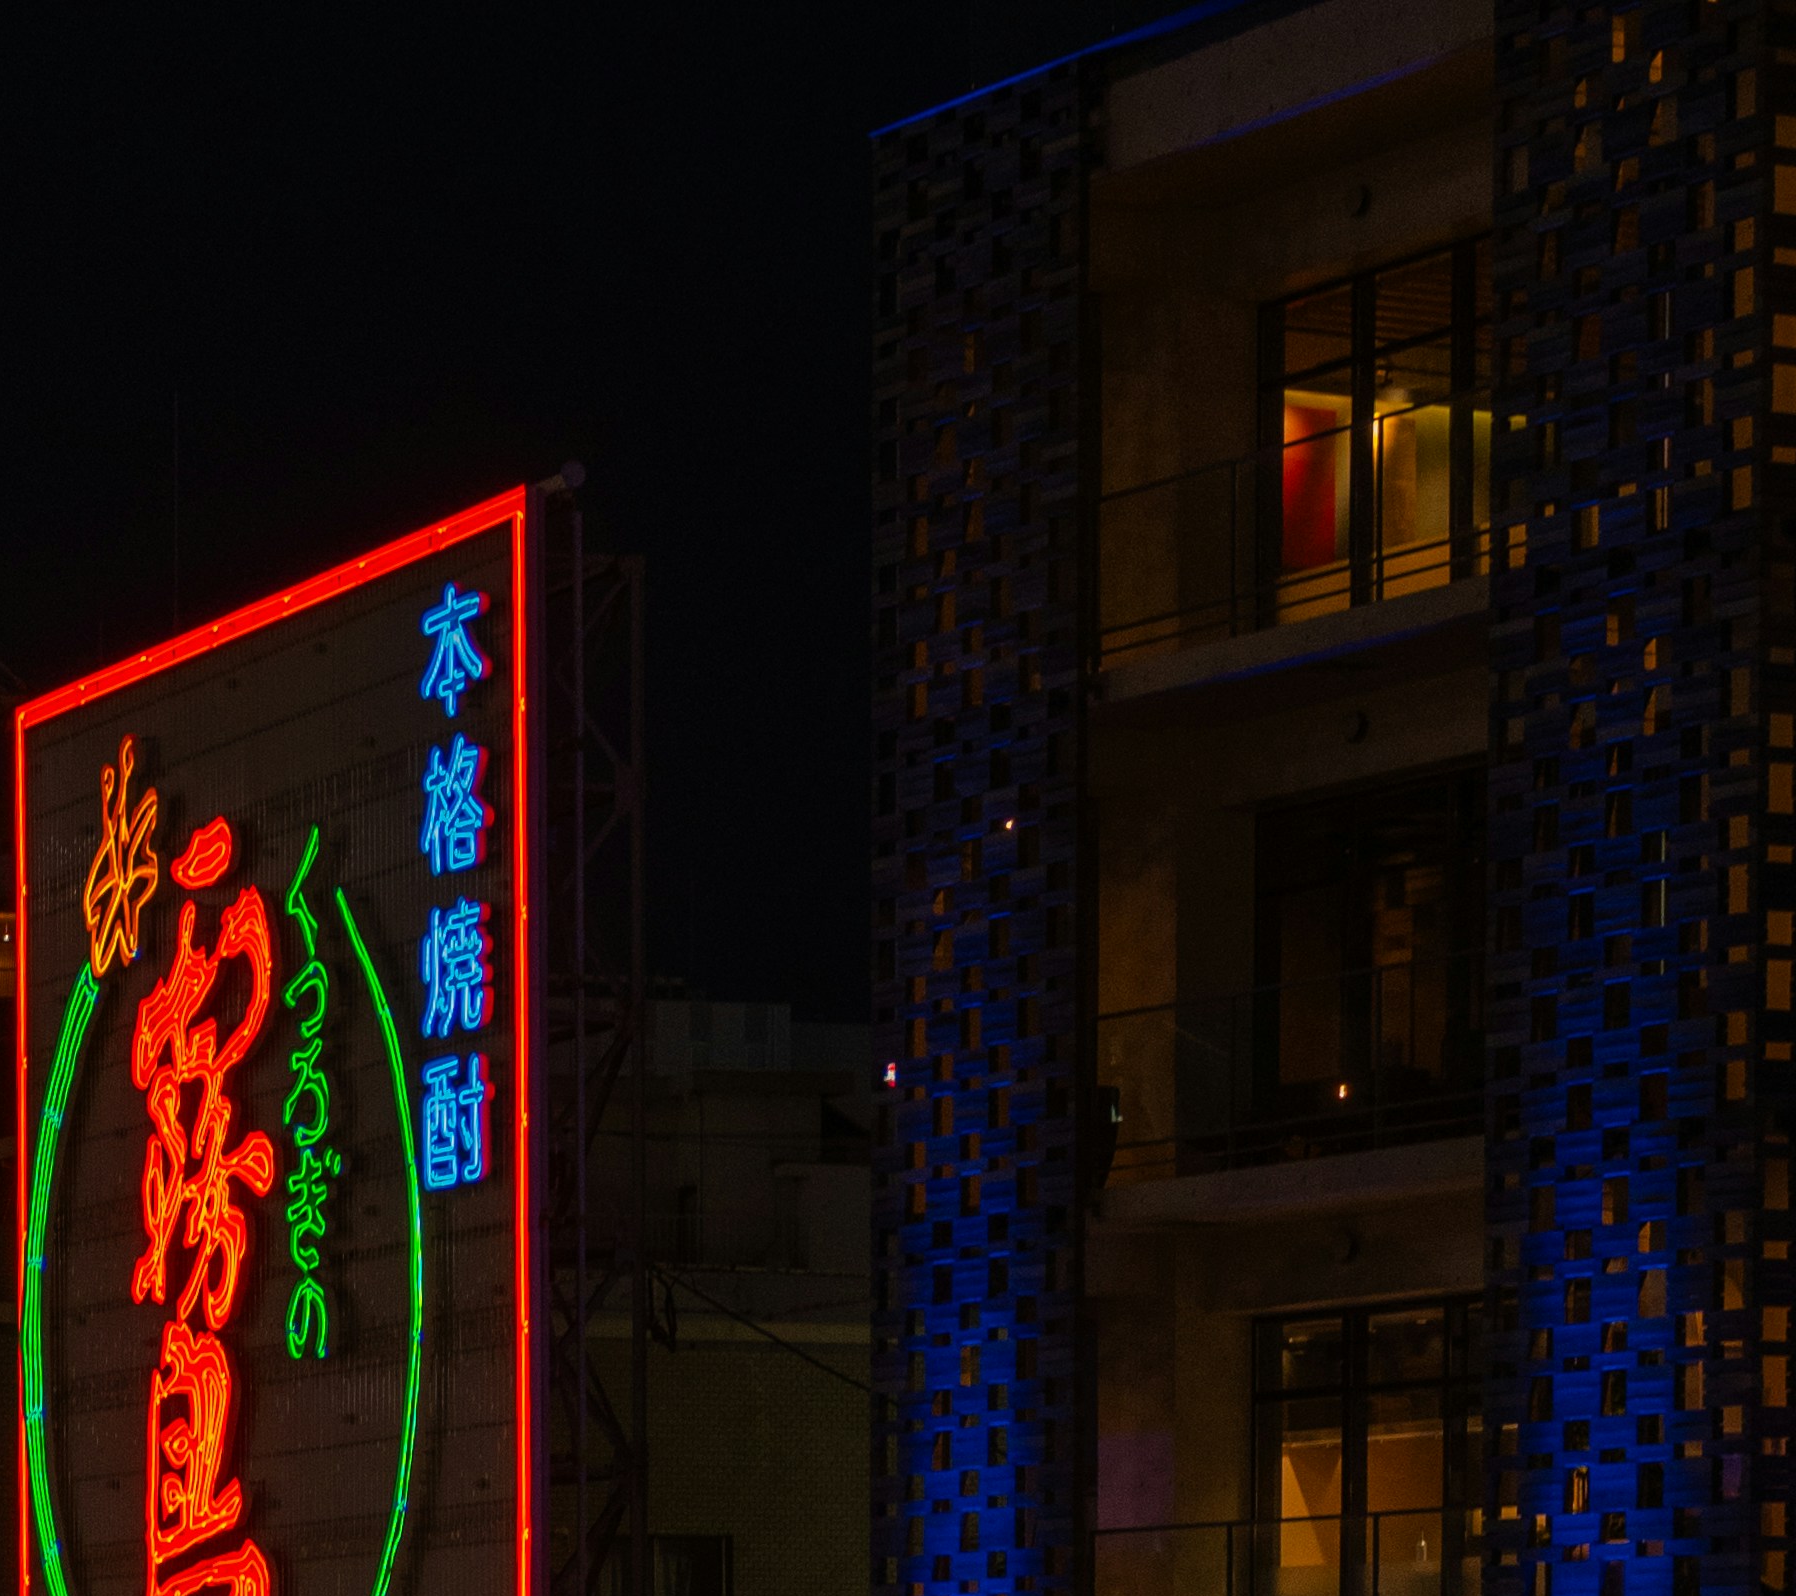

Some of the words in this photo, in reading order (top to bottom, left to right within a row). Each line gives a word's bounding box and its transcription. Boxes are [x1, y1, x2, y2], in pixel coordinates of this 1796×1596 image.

[283, 822, 343, 1360] くつろぎの
[421, 581, 486, 1191] 本格焼酎
